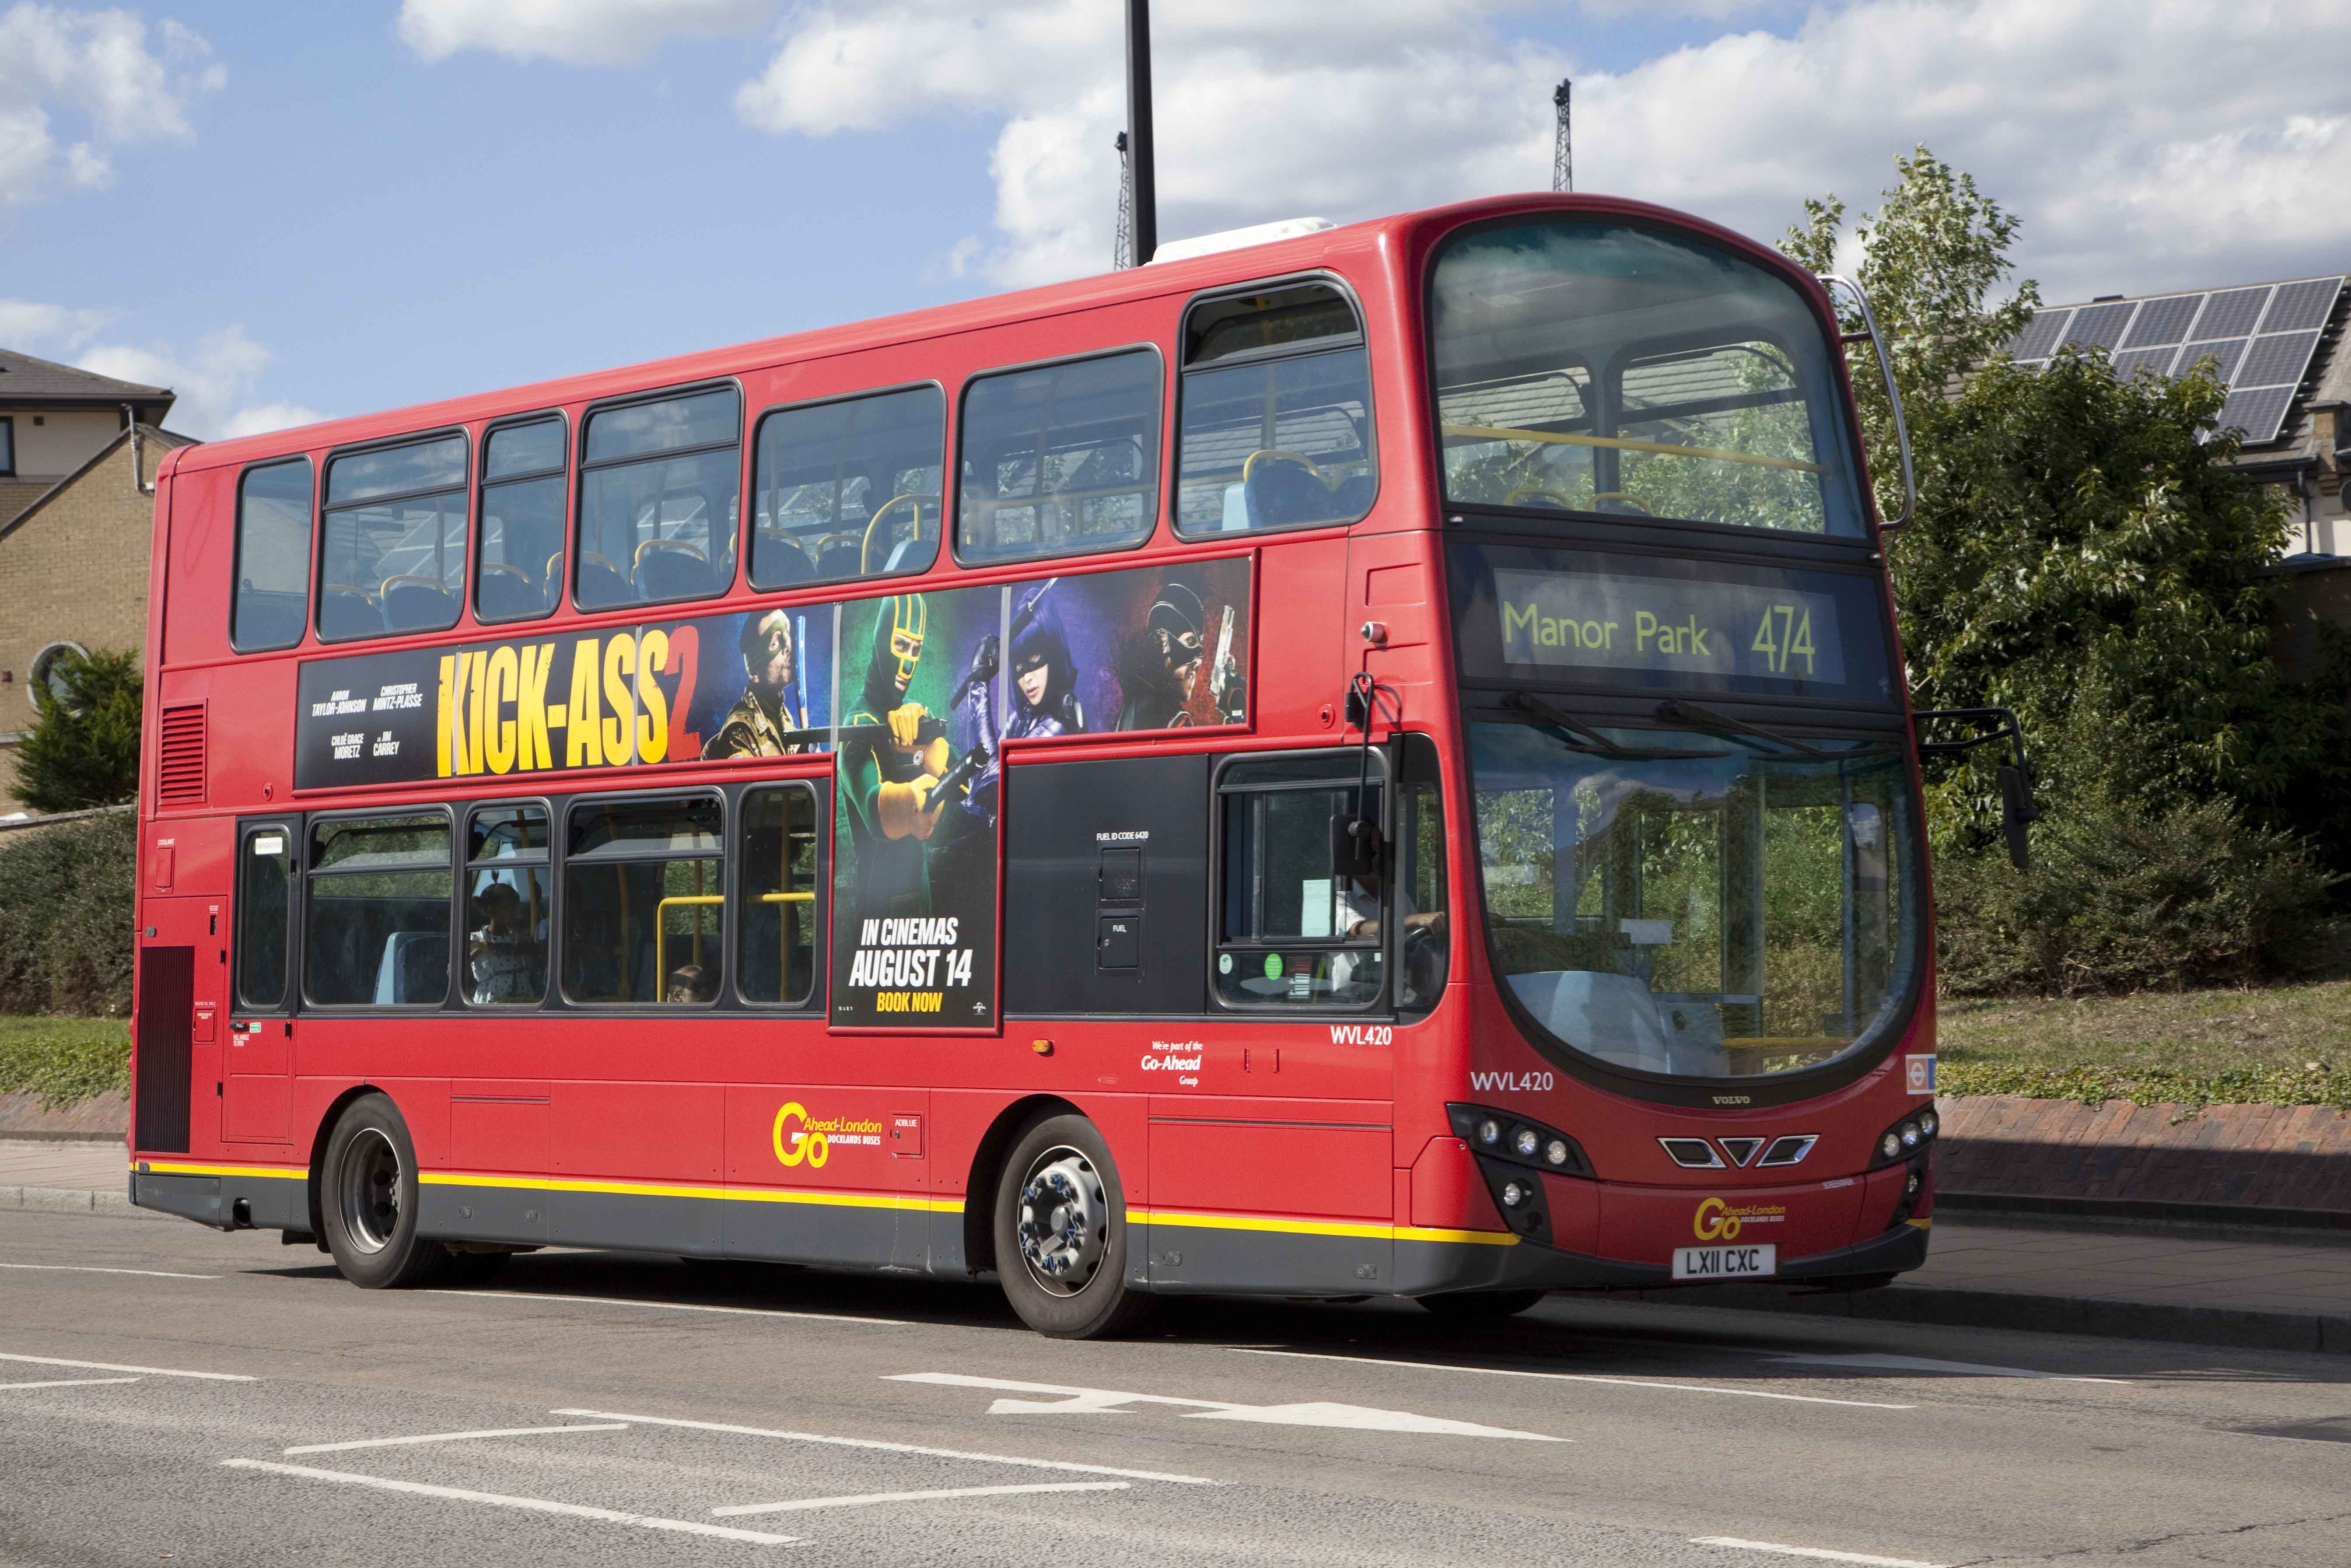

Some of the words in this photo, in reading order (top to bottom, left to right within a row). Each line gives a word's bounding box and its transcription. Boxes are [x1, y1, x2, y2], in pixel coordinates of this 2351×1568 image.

[1503, 601, 1618, 650] Manor
[1635, 611, 1711, 656] Park
[1751, 604, 1816, 675] 474
[331, 690, 350, 701] AARON
[380, 683, 417, 696] CHRISTOPHER
[312, 699, 367, 717] TAYLOR-JOHNSON
[373, 693, 423, 710] MINTZ-PLASSE
[437, 629, 668, 777] KICK-ASS
[663, 625, 701, 762] 2
[347, 733, 364, 746] GRACE
[381, 731, 392, 742] JIM
[334, 745, 361, 760] MORETZ
[373, 741, 400, 756] CARREY
[861, 919, 880, 945] IN
[881, 917, 959, 945] CINEMAS
[849, 949, 941, 987] AUGUST
[946, 949, 973, 987] 14
[876, 992, 910, 1012] BOOK
[911, 992, 943, 1012] NOW
[1330, 1026, 1392, 1046] WVL420
[1152, 1041, 1169, 1050] We're
[1170, 1043, 1184, 1053] part
[1184, 1041, 1193, 1052] of
[1193, 1041, 1203, 1050] the
[1141, 1055, 1202, 1071] Go-Ahead
[1179, 1075, 1199, 1088] Group
[1470, 1072, 1553, 1091] WVL420
[1712, 1096, 1751, 1104] VOLVO
[773, 1102, 829, 1168] Go
[827, 1134, 861, 1144] DOCKLANDS
[862, 1134, 881, 1145] BUSES
[1694, 1197, 1741, 1240] Go
[1686, 1250, 1721, 1274] LX11
[1725, 1249, 1760, 1272] CXC
